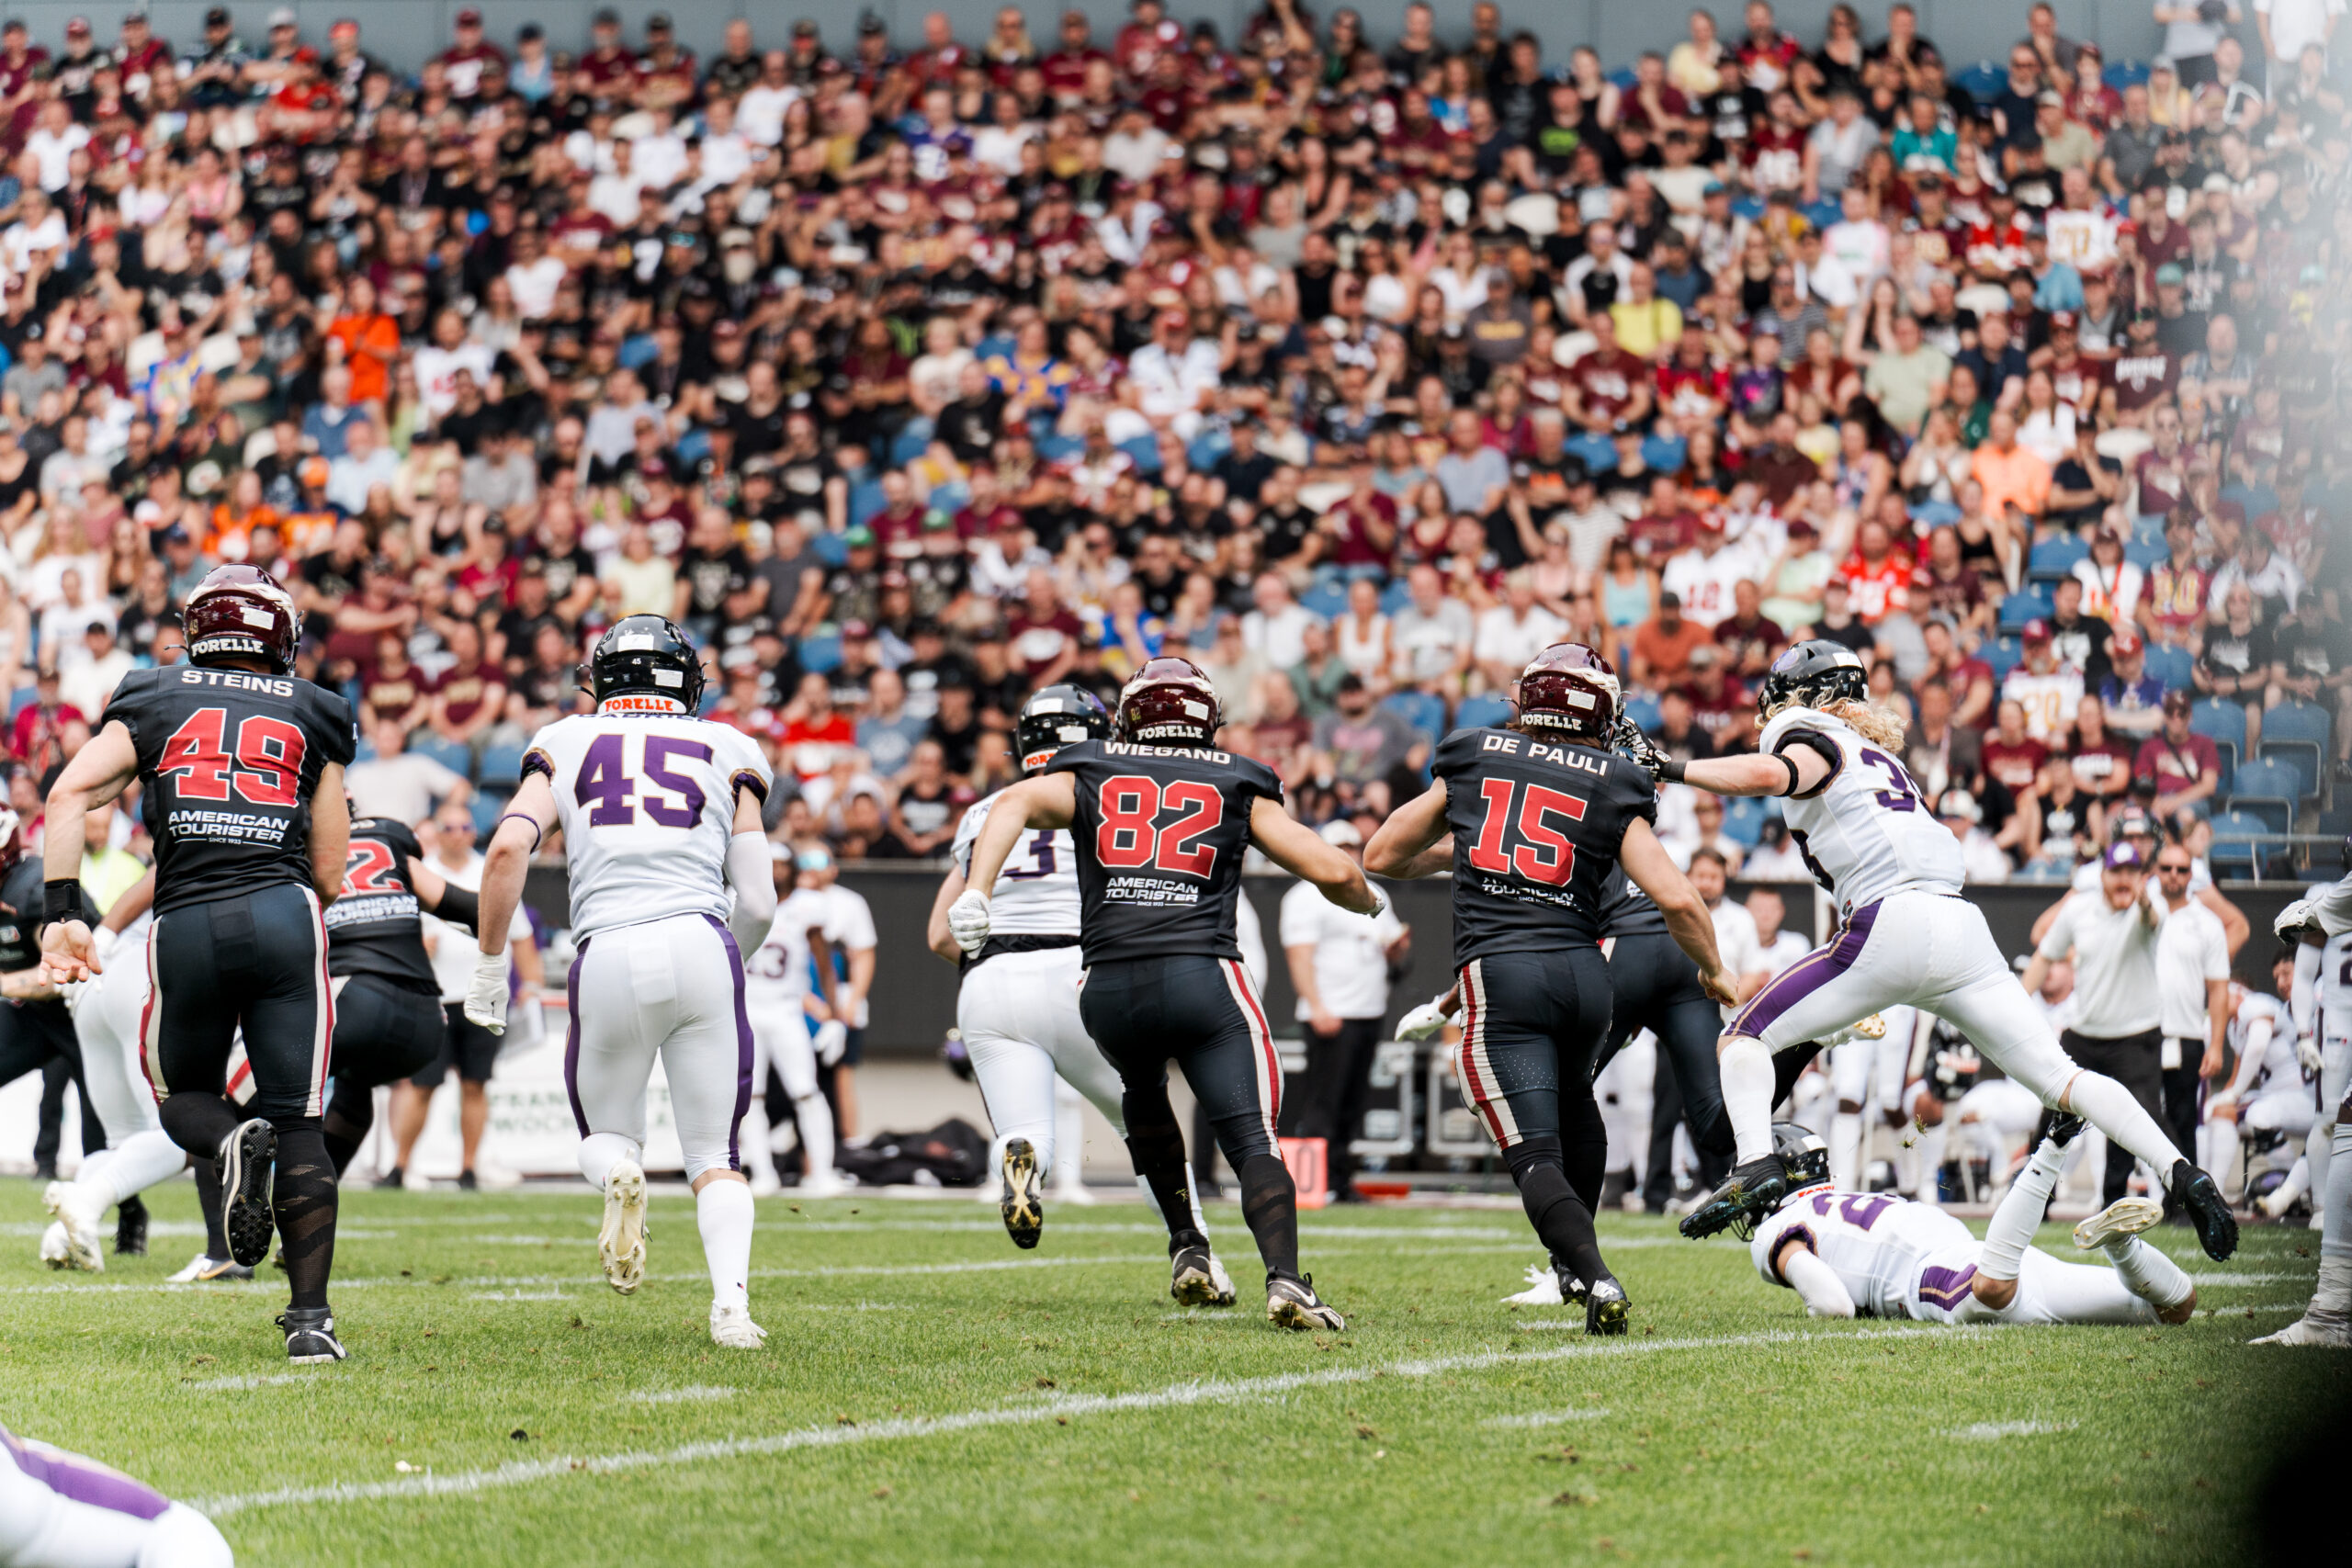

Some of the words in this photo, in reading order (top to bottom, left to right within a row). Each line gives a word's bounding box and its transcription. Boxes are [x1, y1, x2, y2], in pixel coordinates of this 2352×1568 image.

[189, 618, 199, 635] 49
[191, 637, 264, 657] FORELLE
[632, 657, 642, 665] 45
[181, 670, 294, 697] STEINS
[605, 698, 673, 712] FORELLE
[1130, 706, 1141, 721] 82
[1521, 714, 1582, 731] FORELLE
[1137, 725, 1204, 741] FORELLE
[156, 707, 307, 807] 49
[1104, 741, 1231, 765] WIEGAND
[1483, 735, 1521, 754] DE
[1528, 742, 1608, 777] PAULI
[574, 734, 715, 829] 45
[168, 810, 289, 830] AMERICAN
[1096, 775, 1224, 879] 82
[169, 823, 285, 843] TOURISTER
[228, 837, 242, 845] 1933
[1469, 777, 1589, 887] 15
[338, 838, 407, 898] 2
[1105, 888, 1198, 902] TOURISTER
[1107, 877, 1199, 894] AMERICAN
[323, 896, 417, 916] MERICAN
[324, 905, 418, 926] OURISTER
